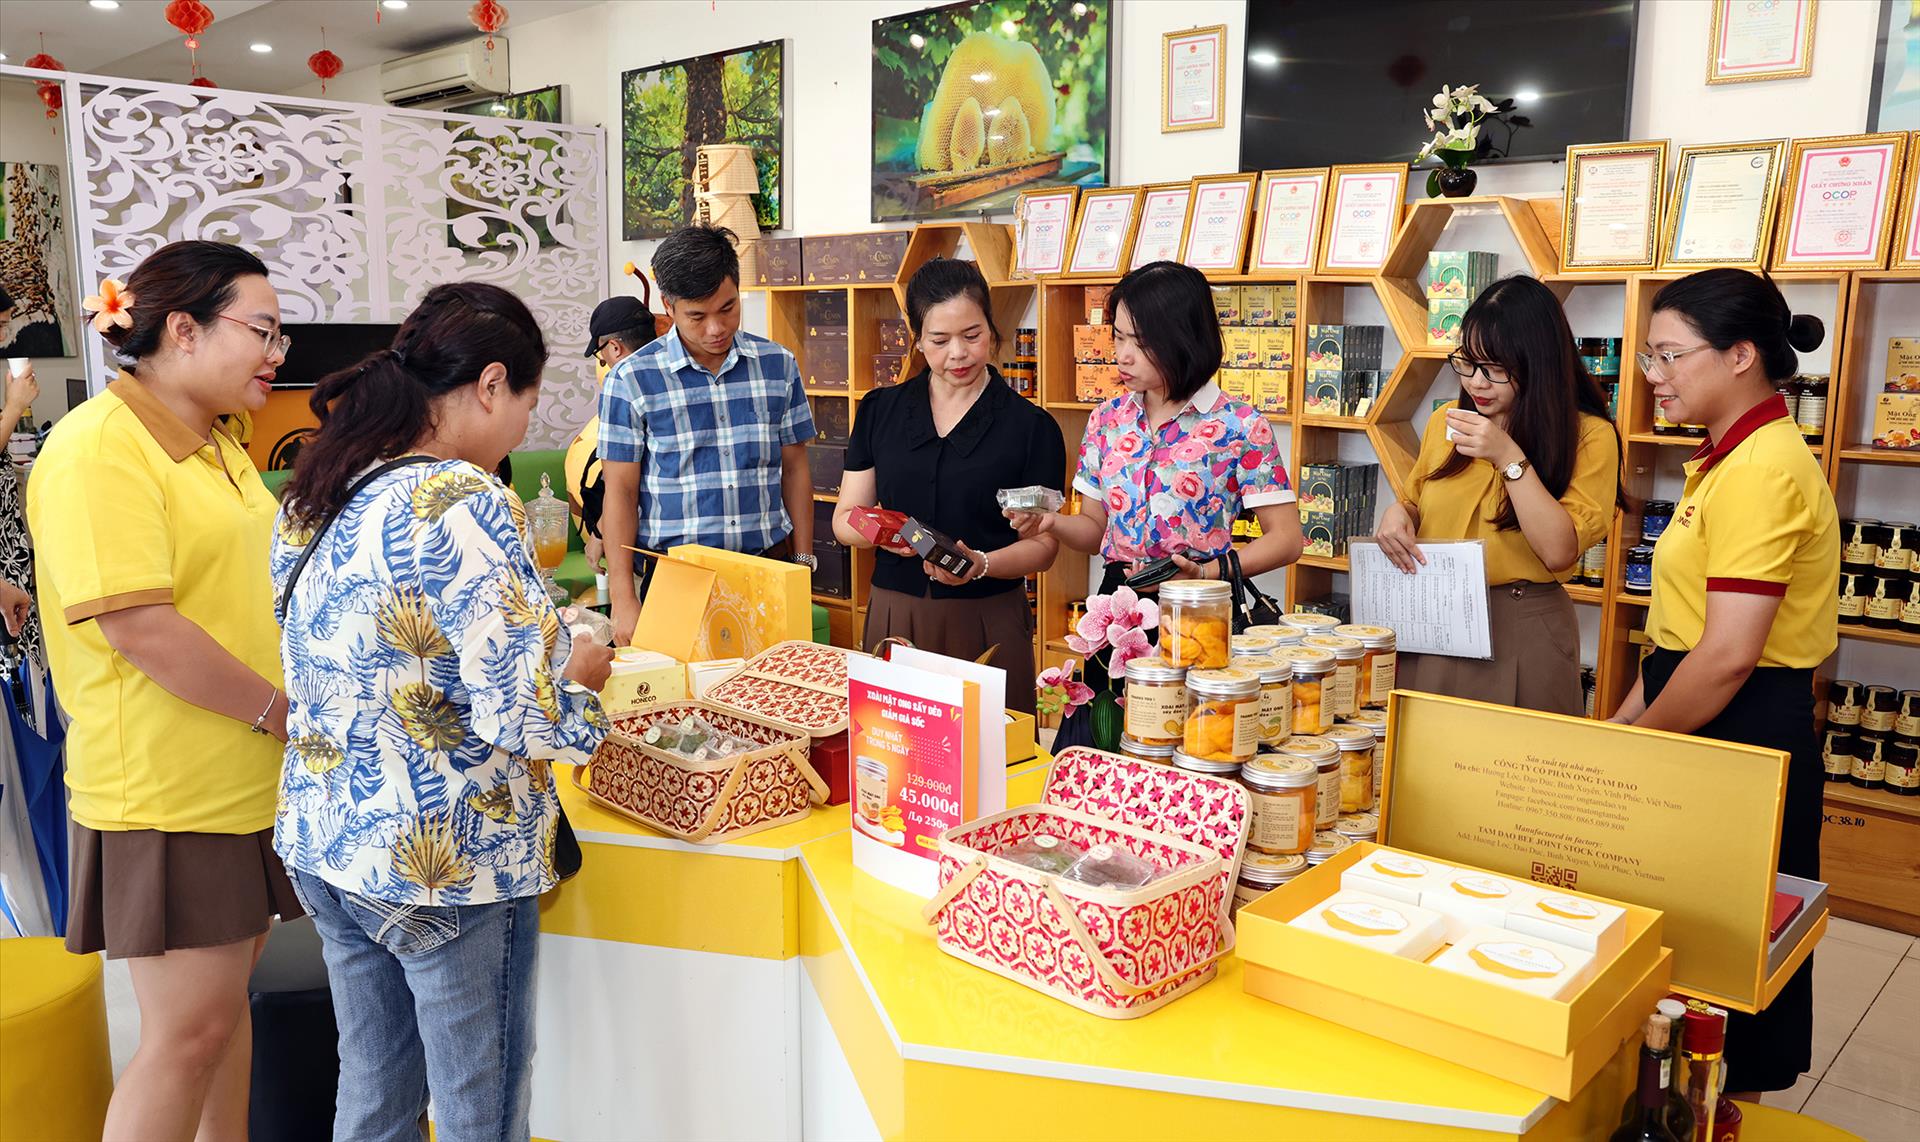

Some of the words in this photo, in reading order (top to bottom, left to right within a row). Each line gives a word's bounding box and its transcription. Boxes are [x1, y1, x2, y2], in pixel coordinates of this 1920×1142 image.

[1823, 190, 1857, 200] OCOP
[631, 696, 657, 705] HONECO
[867, 689, 882, 703] XOÀI
[882, 694, 897, 707] MẬT
[898, 698, 912, 709] ONG
[912, 701, 927, 714] SẤY
[928, 705, 942, 717] DẺO
[882, 708, 898, 721] GIẢM
[898, 712, 910, 724] GIÁ
[911, 716, 925, 728] SỐC
[872, 727, 884, 737] DUY
[884, 730, 903, 743] NHẤT
[866, 736, 886, 749] TRONG
[886, 743, 891, 751] 5
[1494, 758, 1518, 769] CÔNG
[1520, 764, 1533, 772] TY
[1574, 773, 1593, 784] ONG
[907, 773, 952, 795] 129.000đ
[1500, 780, 1526, 792] Website
[900, 786, 960, 816] 45.000đ
[1495, 790, 1525, 802] Fanpage:
[1497, 800, 1523, 811] Hotline:
[1663, 801, 1682, 811] Nam
[908, 811, 922, 824] /Lọ
[1515, 824, 1564, 840] Manufactured
[1574, 838, 1603, 848] factory:
[1479, 826, 1496, 836] TAM
[1498, 830, 1516, 840] DAO
[1518, 834, 1533, 843] BEE
[1536, 837, 1561, 849] JOINT
[1564, 844, 1594, 856] STOCK
[1595, 851, 1642, 866] COMPANY
[1456, 831, 1473, 840] Add:
[1473, 835, 1496, 847] Huong
[1497, 840, 1512, 850] Loc,
[1514, 844, 1528, 852] Dao
[1529, 847, 1544, 857] Duc,
[1547, 850, 1564, 860] Binh
[1566, 854, 1590, 866] Xuyen,
[1592, 860, 1610, 871] Vinh
[1611, 864, 1632, 876] Phuc,
[1633, 869, 1665, 882] Vietnam
